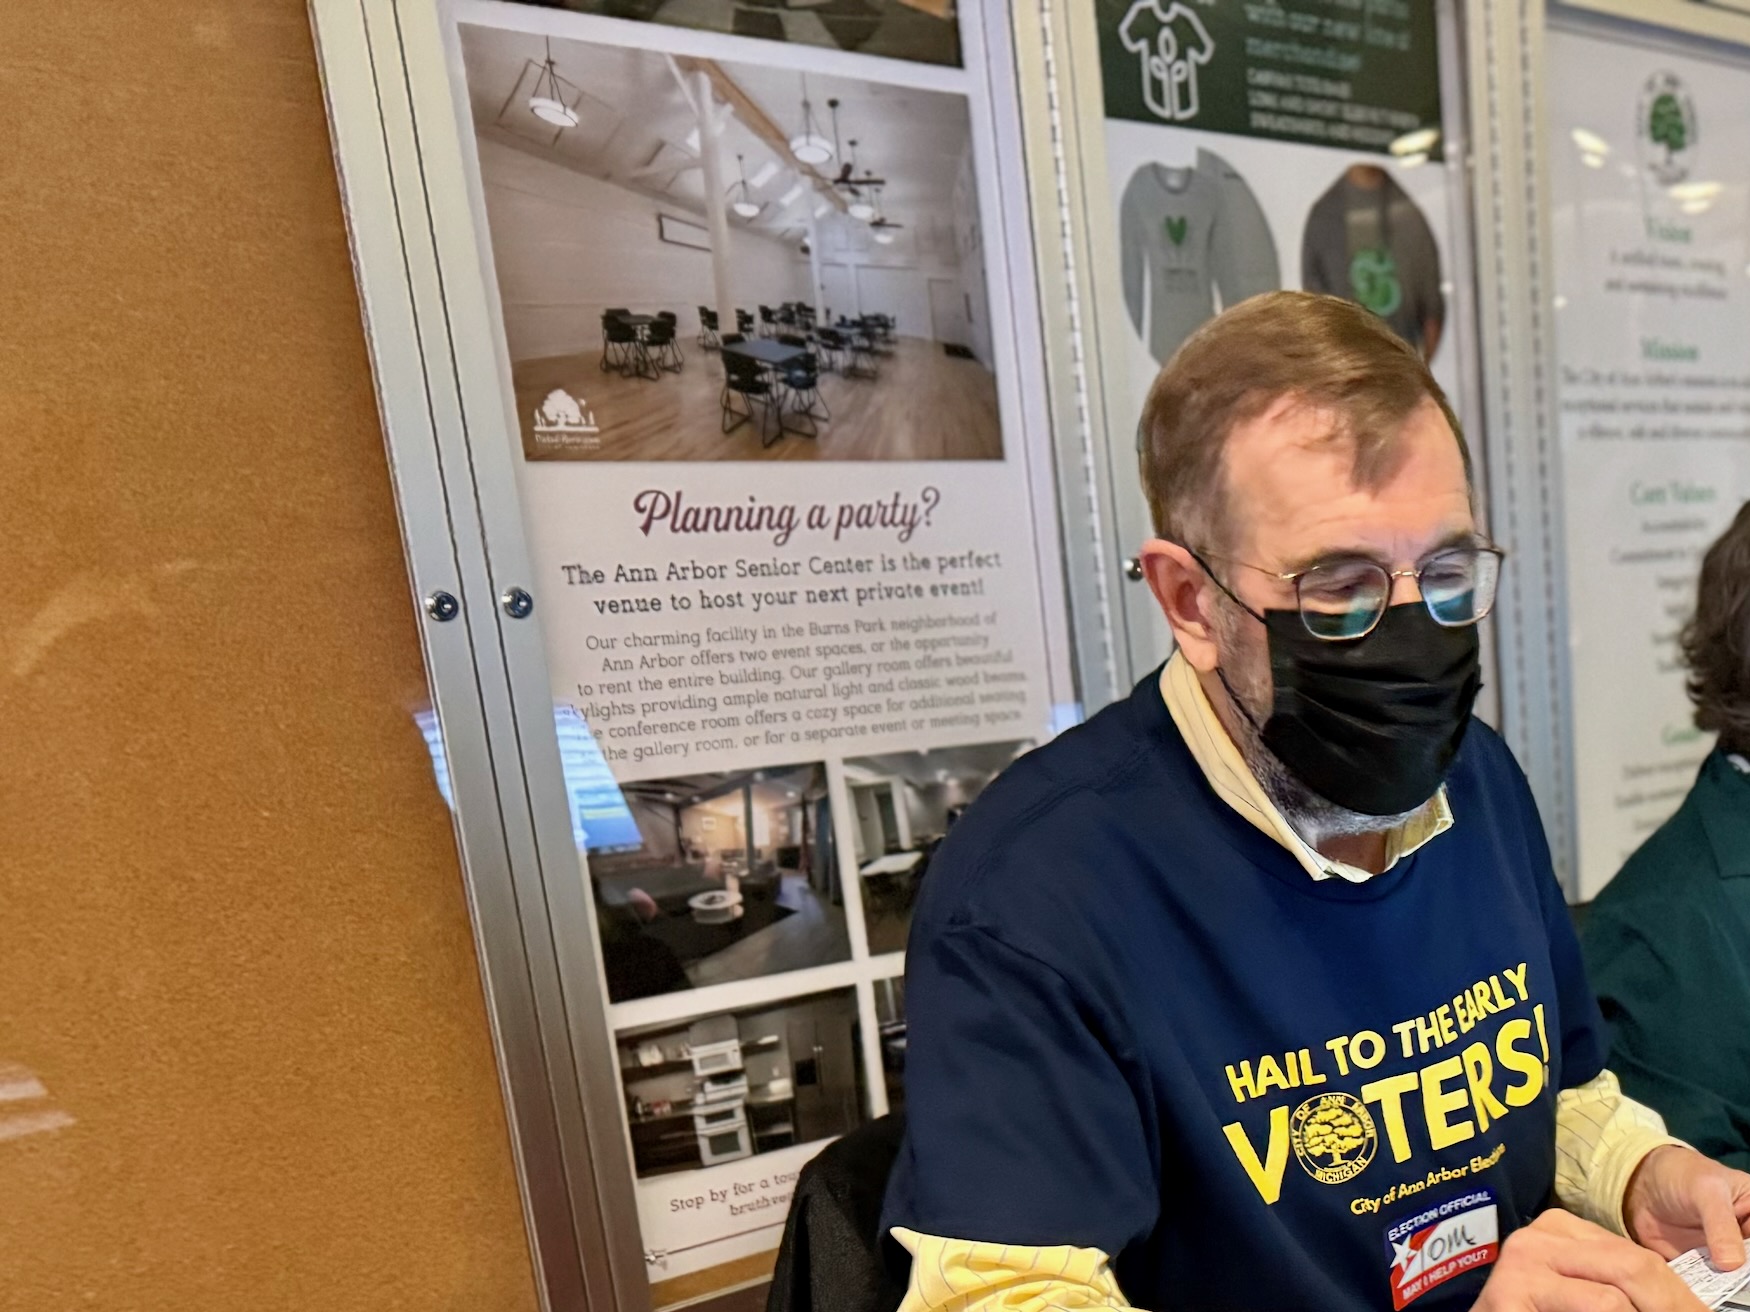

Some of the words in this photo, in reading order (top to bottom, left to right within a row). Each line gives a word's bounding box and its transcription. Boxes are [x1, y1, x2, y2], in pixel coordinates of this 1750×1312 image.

[633, 490, 799, 545] Planning
[806, 511, 830, 531] a
[832, 487, 940, 542] party?
[561, 563, 604, 585] The
[614, 563, 657, 583] Ann
[666, 560, 727, 581] Arbor
[735, 558, 800, 578] Senior
[809, 555, 874, 575] Center
[881, 554, 897, 572] is
[902, 552, 931, 571] the
[938, 550, 1002, 574] perfect
[594, 597, 661, 615] venue
[671, 593, 691, 611] to
[699, 589, 743, 610] host
[752, 589, 797, 613] your
[805, 587, 849, 605] next
[856, 582, 923, 607] private
[929, 579, 986, 598] event!
[586, 634, 618, 651] Our
[623, 629, 701, 649] charming
[706, 625, 758, 645] facility
[763, 623, 778, 639] in
[782, 620, 805, 637] the
[809, 620, 851, 635] Burns
[855, 617, 888, 633] Park
[601, 657, 634, 672] Ann
[639, 653, 686, 669] Arbor
[690, 648, 736, 666] offers
[739, 647, 768, 662] two
[772, 644, 810, 660] event
[871, 639, 885, 653] or
[890, 636, 911, 652] the
[577, 683, 594, 697] to
[598, 679, 632, 694] rent
[638, 674, 663, 691] the
[668, 672, 715, 689] entire
[719, 667, 786, 687] building.
[791, 664, 818, 679] Our
[823, 660, 873, 681] gallery
[876, 657, 911, 672] room
[914, 653, 953, 671] offers
[609, 717, 696, 739] conference
[701, 715, 740, 730] room
[745, 709, 788, 726] offers
[792, 709, 802, 721] a
[806, 705, 838, 724] cozy
[842, 701, 882, 719] space
[887, 698, 906, 713] for
[641, 695, 718, 718] providing
[723, 690, 769, 710] ample
[774, 684, 828, 701] natural
[832, 683, 864, 700] light
[868, 679, 894, 693] and
[898, 677, 941, 692] classic
[633, 740, 690, 763] gallery
[743, 734, 760, 747] or
[764, 729, 786, 745] for
[790, 731, 801, 743] a
[804, 724, 867, 743] separate
[871, 720, 908, 735] event
[911, 717, 926, 731] or
[1225, 1048, 1327, 1103] HAIL
[1325, 1030, 1387, 1077] TO
[1392, 1003, 1459, 1059] THE
[1452, 962, 1530, 1035] EARLY
[670, 1195, 704, 1213] Stop
[709, 1188, 728, 1203] by
[733, 1182, 755, 1196] for
[759, 1179, 770, 1189] a
[774, 1171, 800, 1185] tou
[1350, 1197, 1381, 1215] City
[1383, 1186, 1396, 1205] of
[1398, 1180, 1425, 1199] Ann
[1426, 1164, 1469, 1188] Arbor
[1388, 1208, 1439, 1242] ELECTION
[1438, 1191, 1492, 1216] OFFICIAL
[1402, 1280, 1423, 1300] MAY
[1423, 1276, 1429, 1287] I
[1429, 1261, 1457, 1286] HELP
[1457, 1249, 1489, 1269] YOU?
